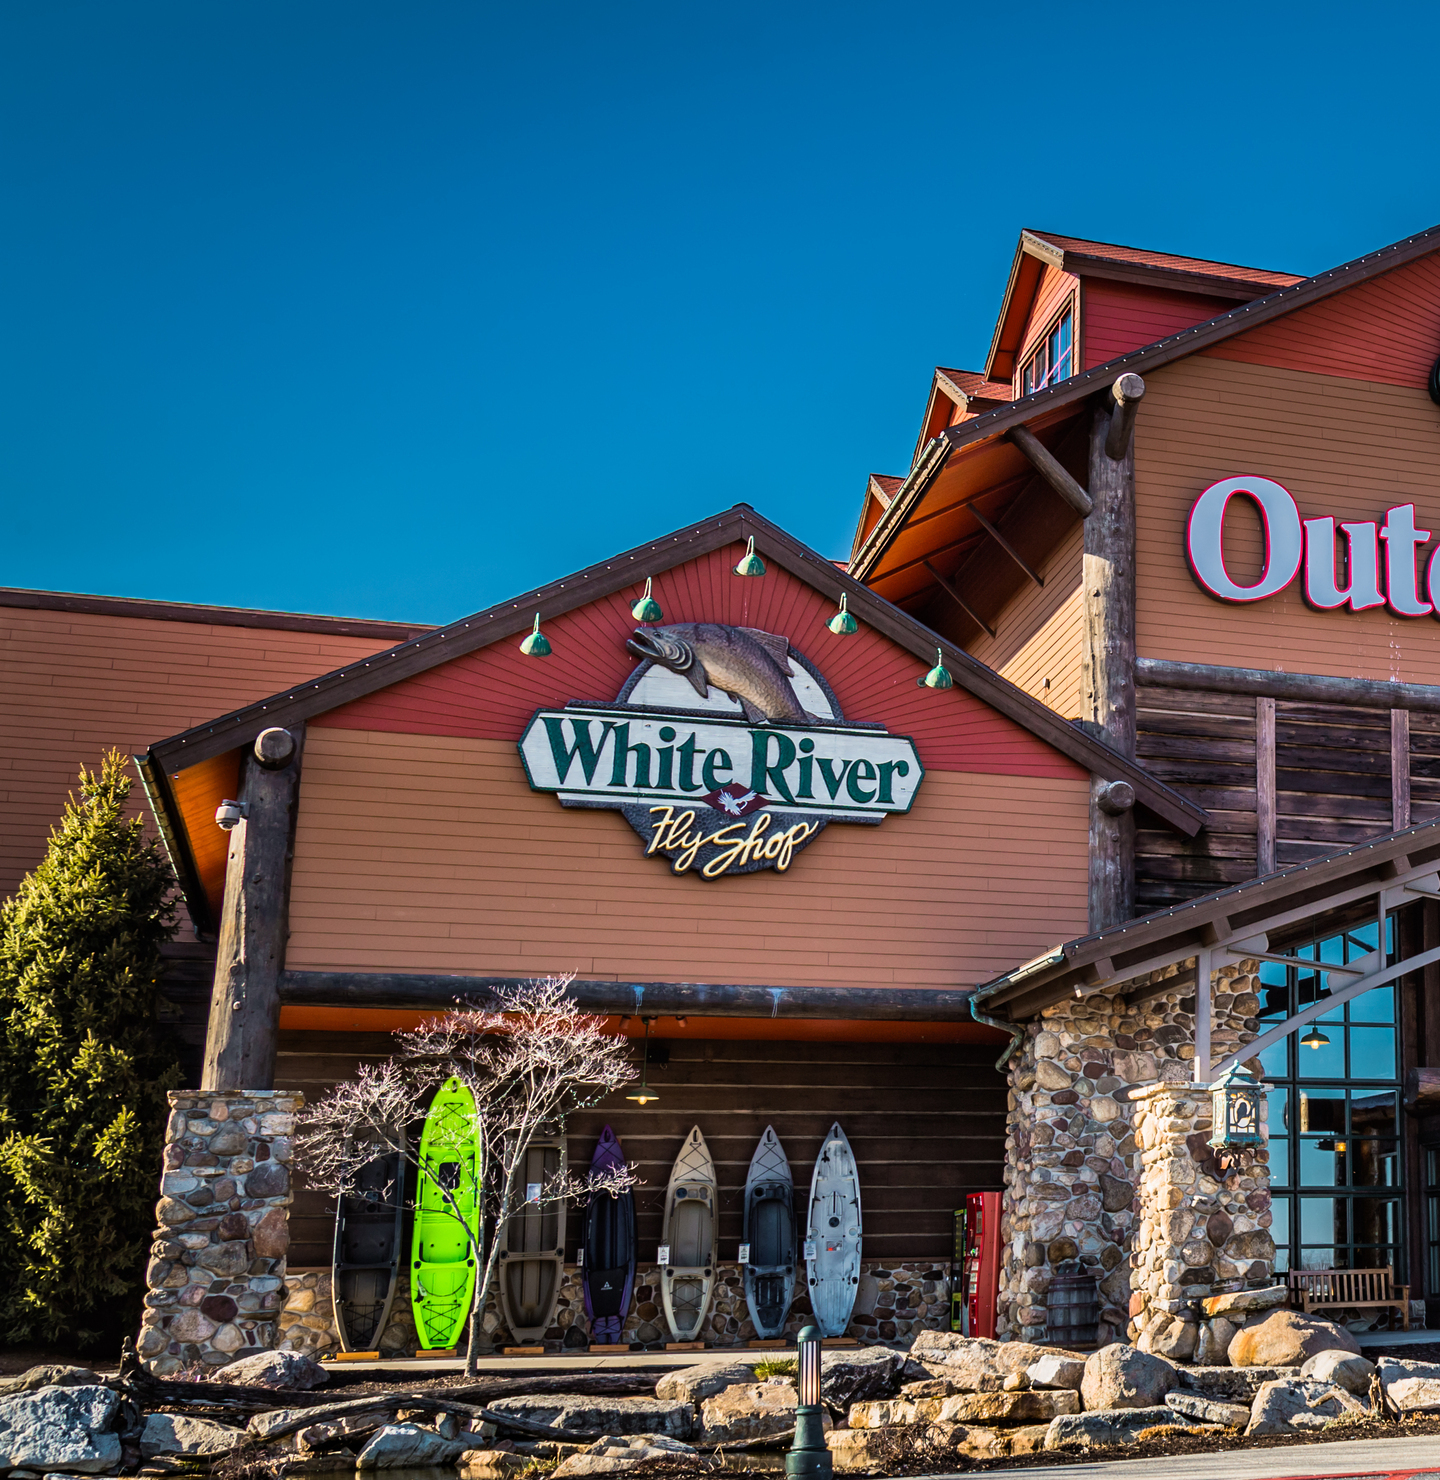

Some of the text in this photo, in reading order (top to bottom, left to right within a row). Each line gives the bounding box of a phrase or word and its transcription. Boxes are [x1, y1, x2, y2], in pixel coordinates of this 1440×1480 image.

[541, 717, 910, 806] White River
[648, 805, 819, 878] Fly Shop
